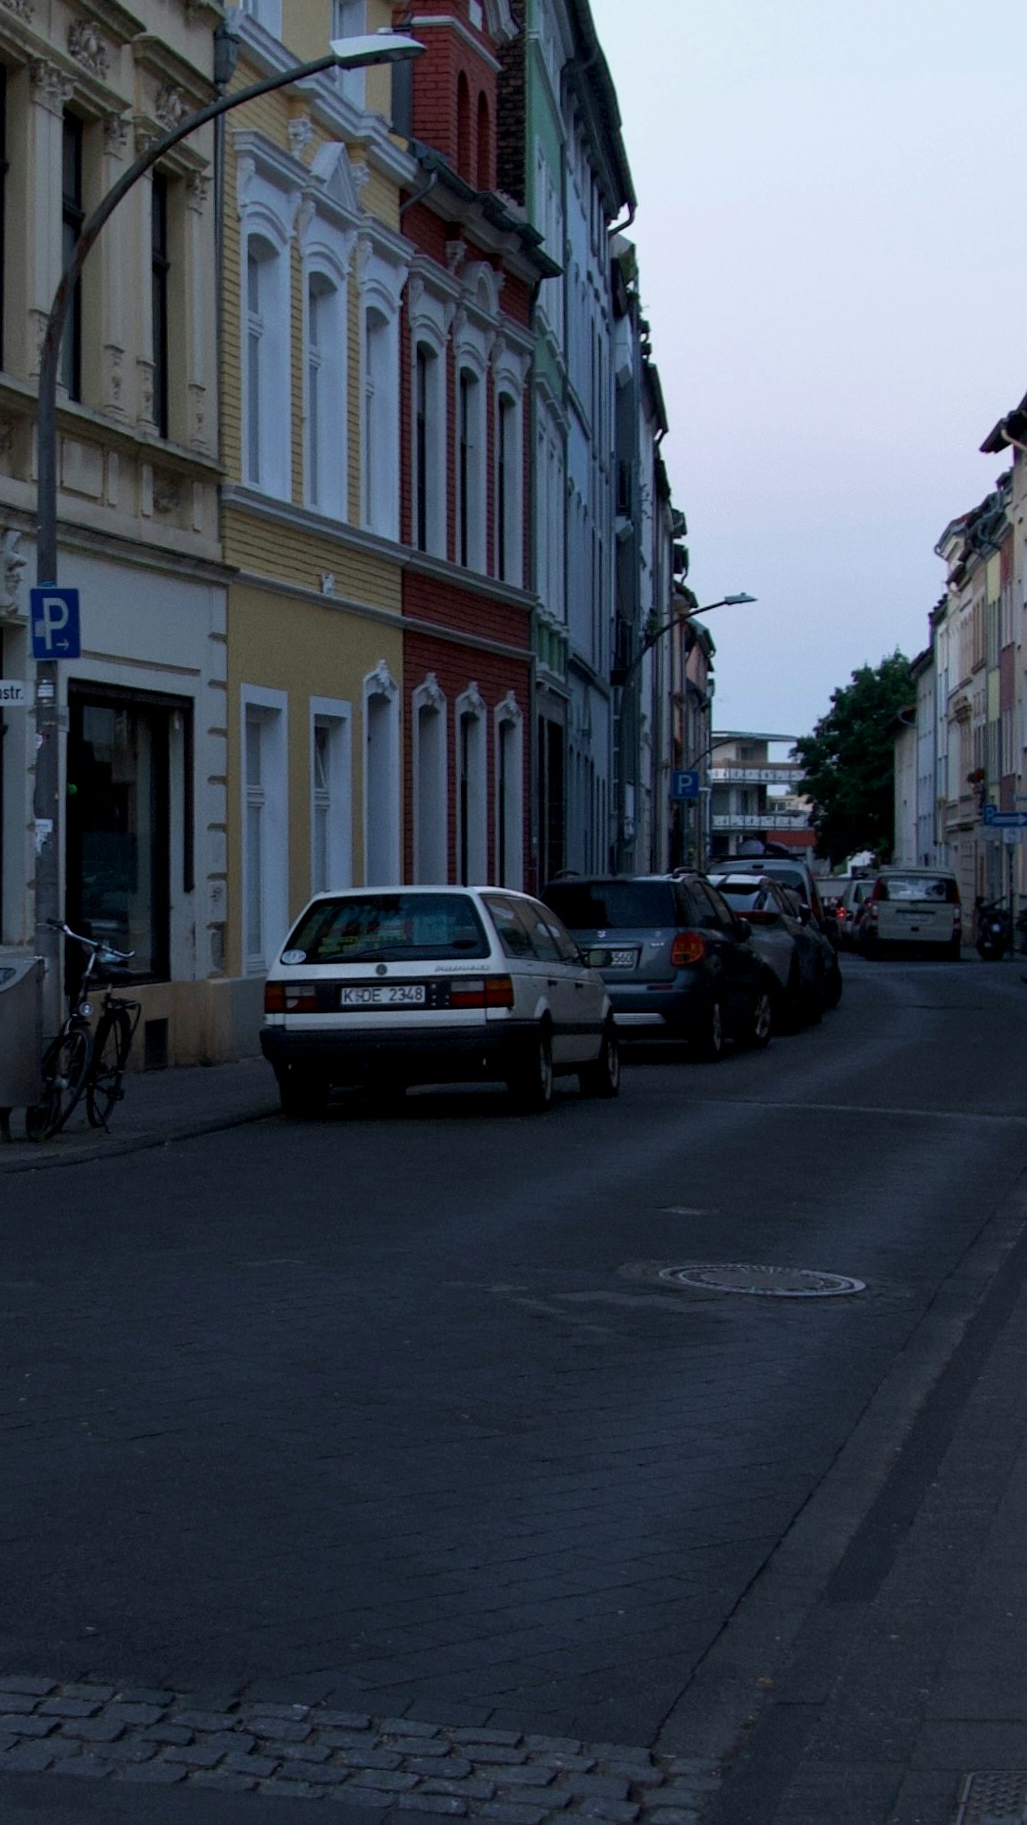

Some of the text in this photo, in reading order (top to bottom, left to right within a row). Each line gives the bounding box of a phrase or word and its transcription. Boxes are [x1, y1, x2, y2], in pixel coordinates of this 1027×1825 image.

[43, 598, 69, 650] P
[678, 774, 693, 795] P
[389, 987, 423, 1002] 2348
